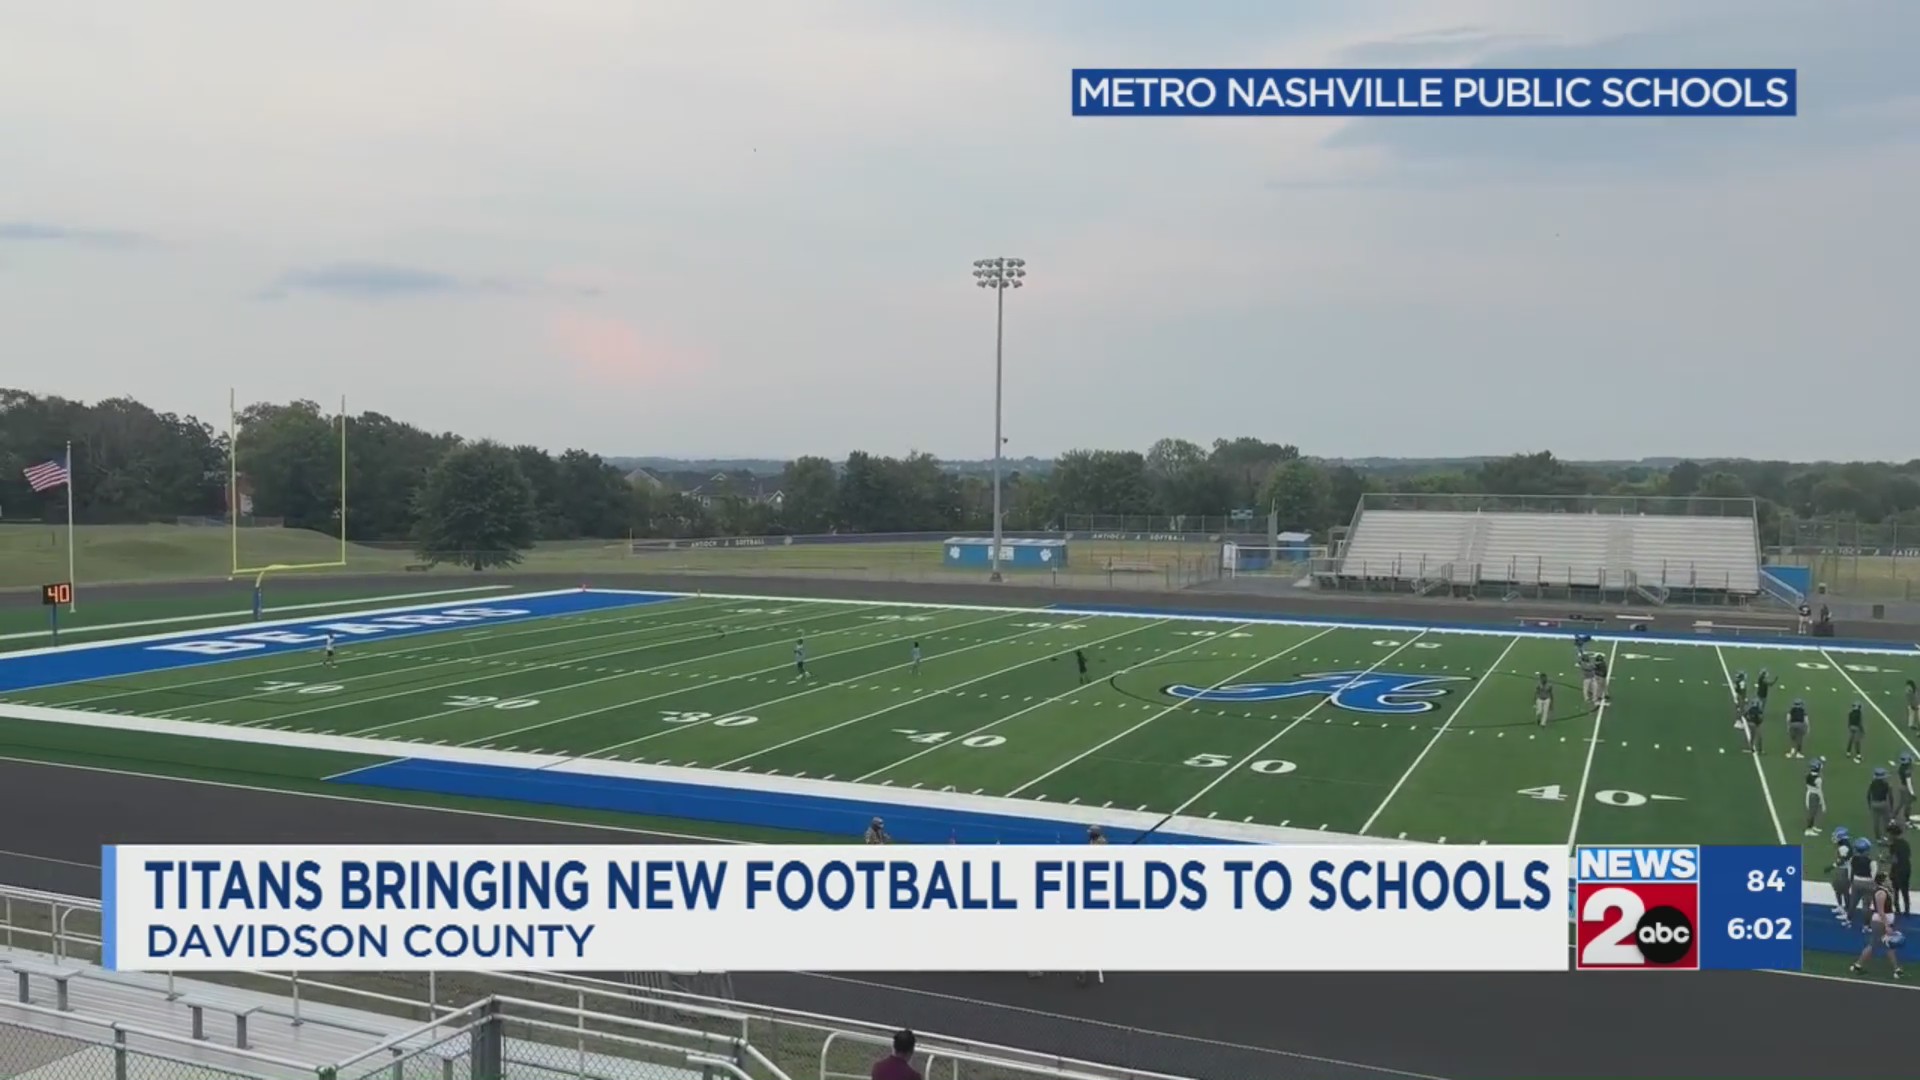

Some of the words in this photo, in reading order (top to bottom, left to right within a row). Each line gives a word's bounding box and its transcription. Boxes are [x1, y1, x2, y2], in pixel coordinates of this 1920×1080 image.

[47, 584, 70, 602] 40
[143, 607, 532, 656] BEARS
[661, 710, 759, 727] 30
[905, 729, 1008, 748] 40
[1182, 752, 1298, 775] 50
[1516, 784, 1647, 807] 40
